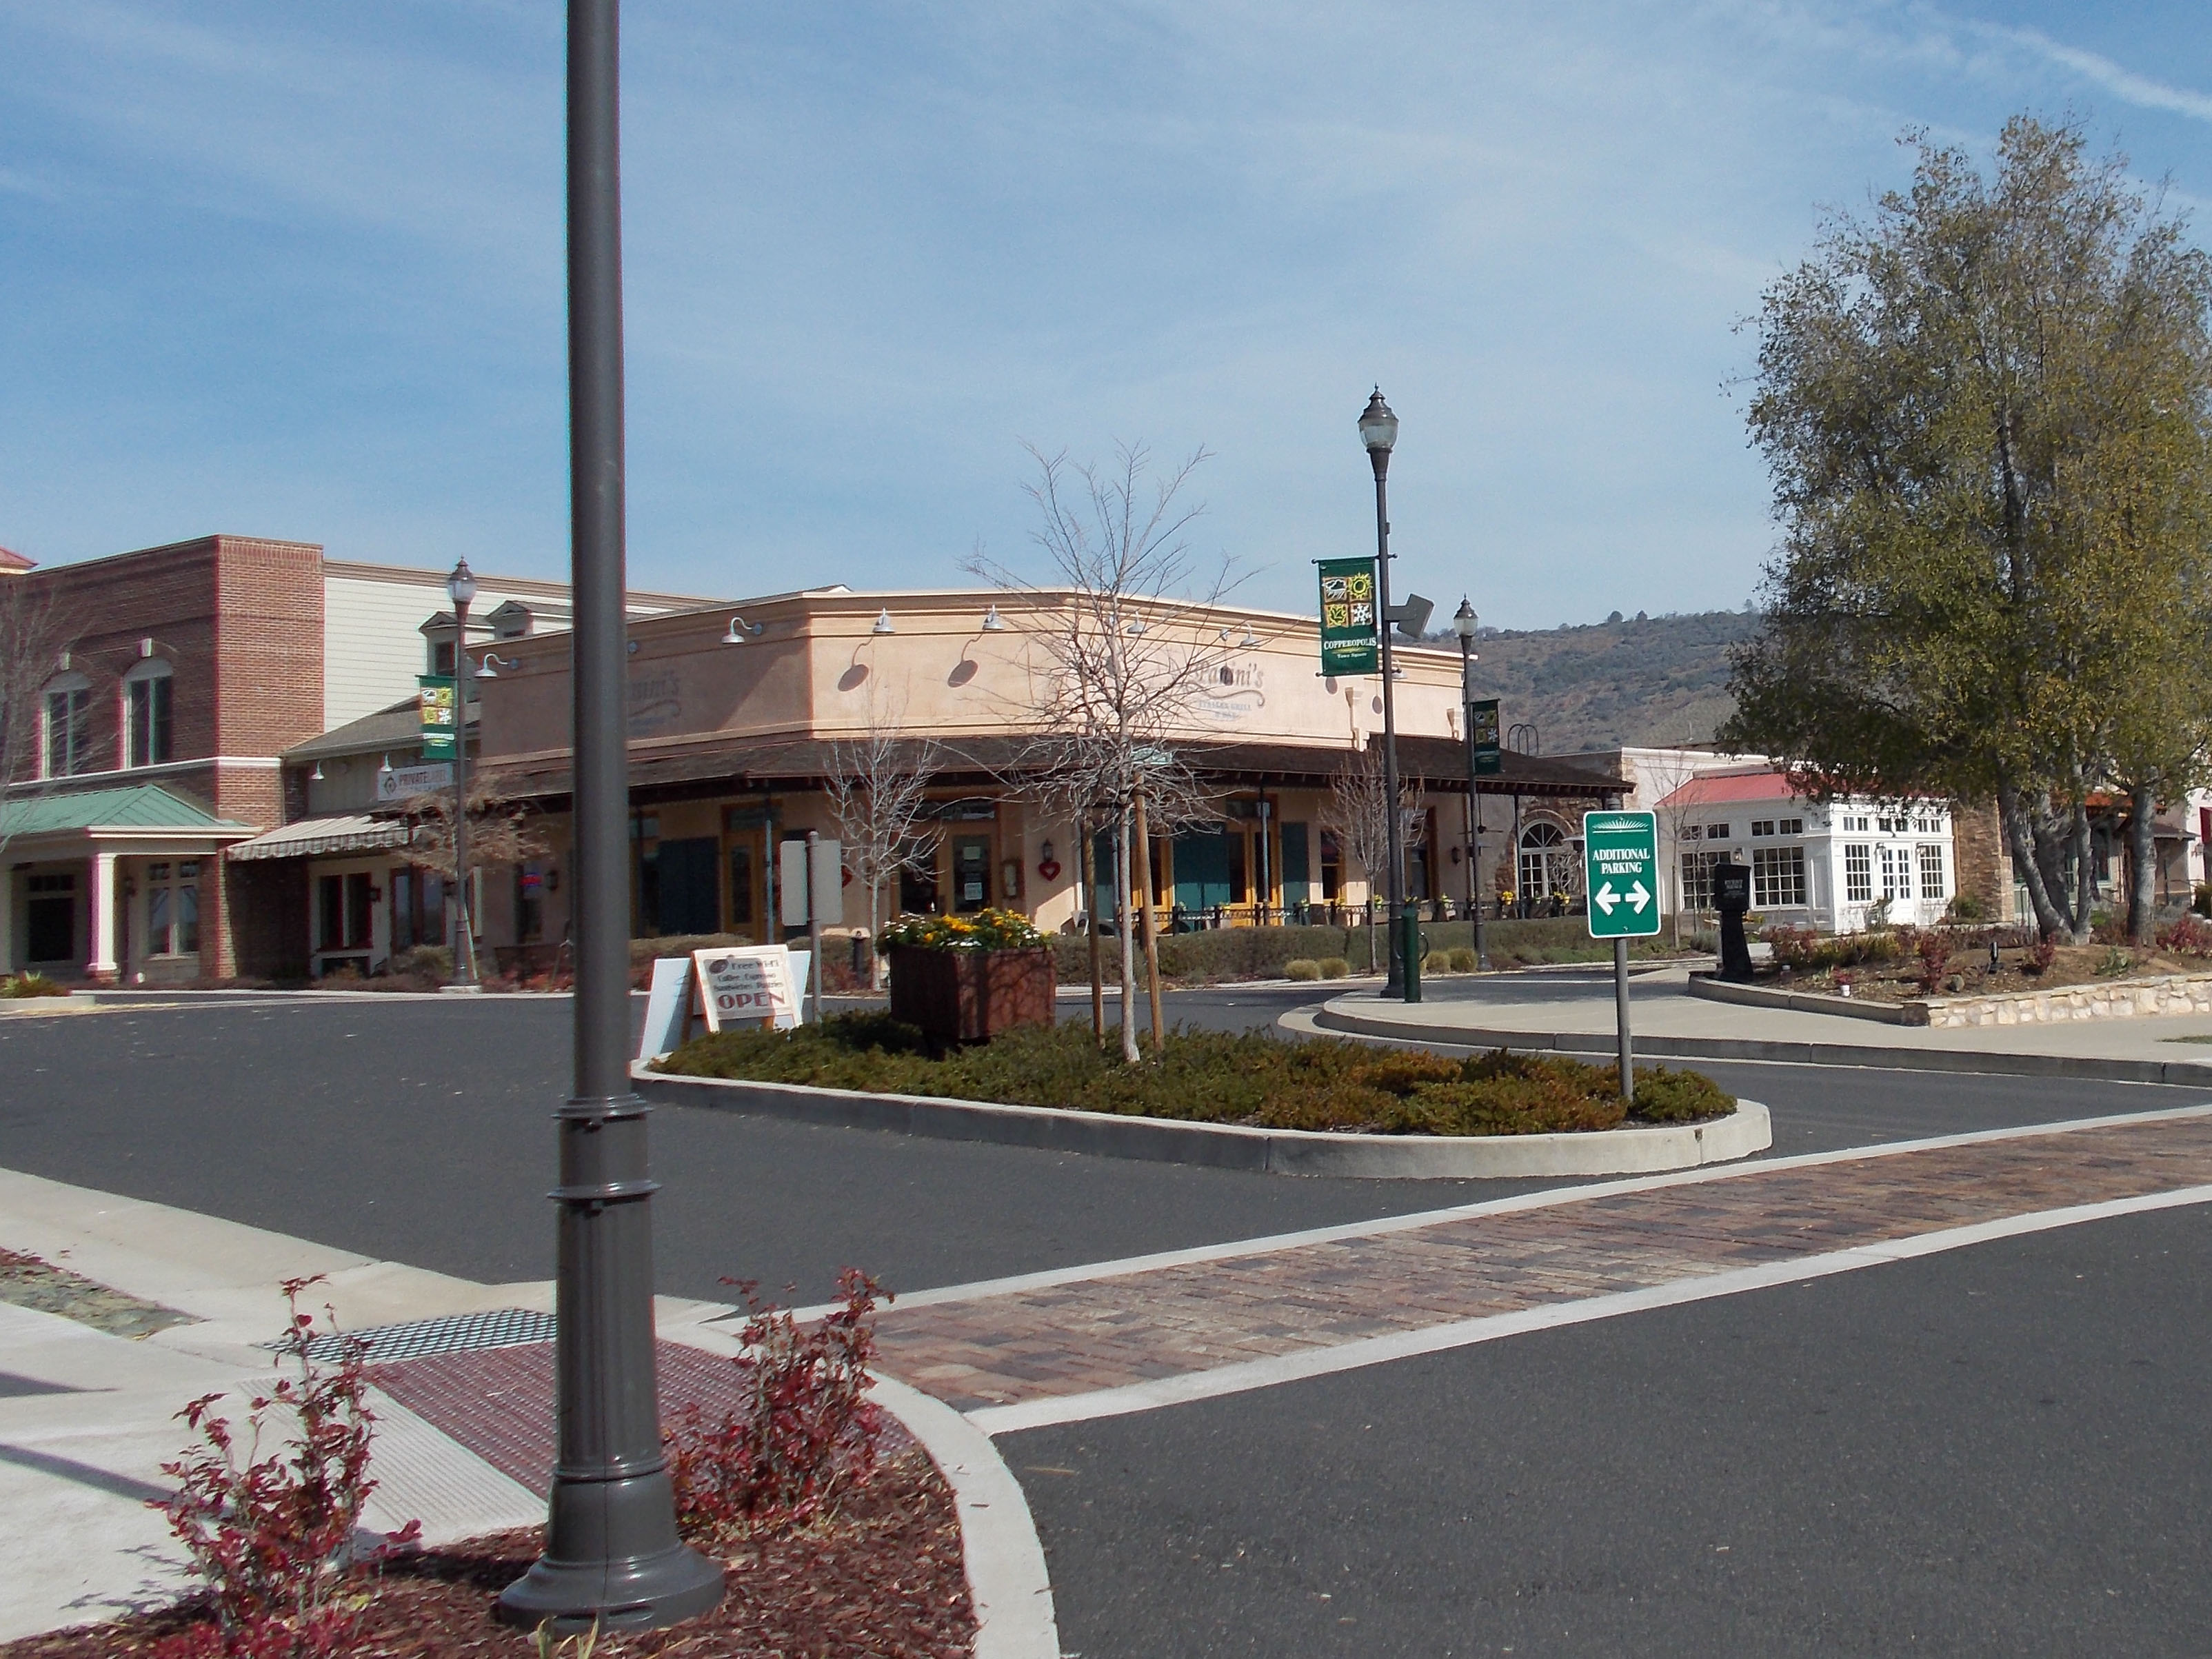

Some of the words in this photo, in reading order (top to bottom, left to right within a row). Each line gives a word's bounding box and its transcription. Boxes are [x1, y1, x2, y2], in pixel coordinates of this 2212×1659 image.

[1324, 637, 1377, 650] COPPEROPOLIS
[1592, 847, 1651, 861] ADDITIONAL
[1601, 862, 1642, 874] PARKING
[718, 991, 785, 1009] OPEN
